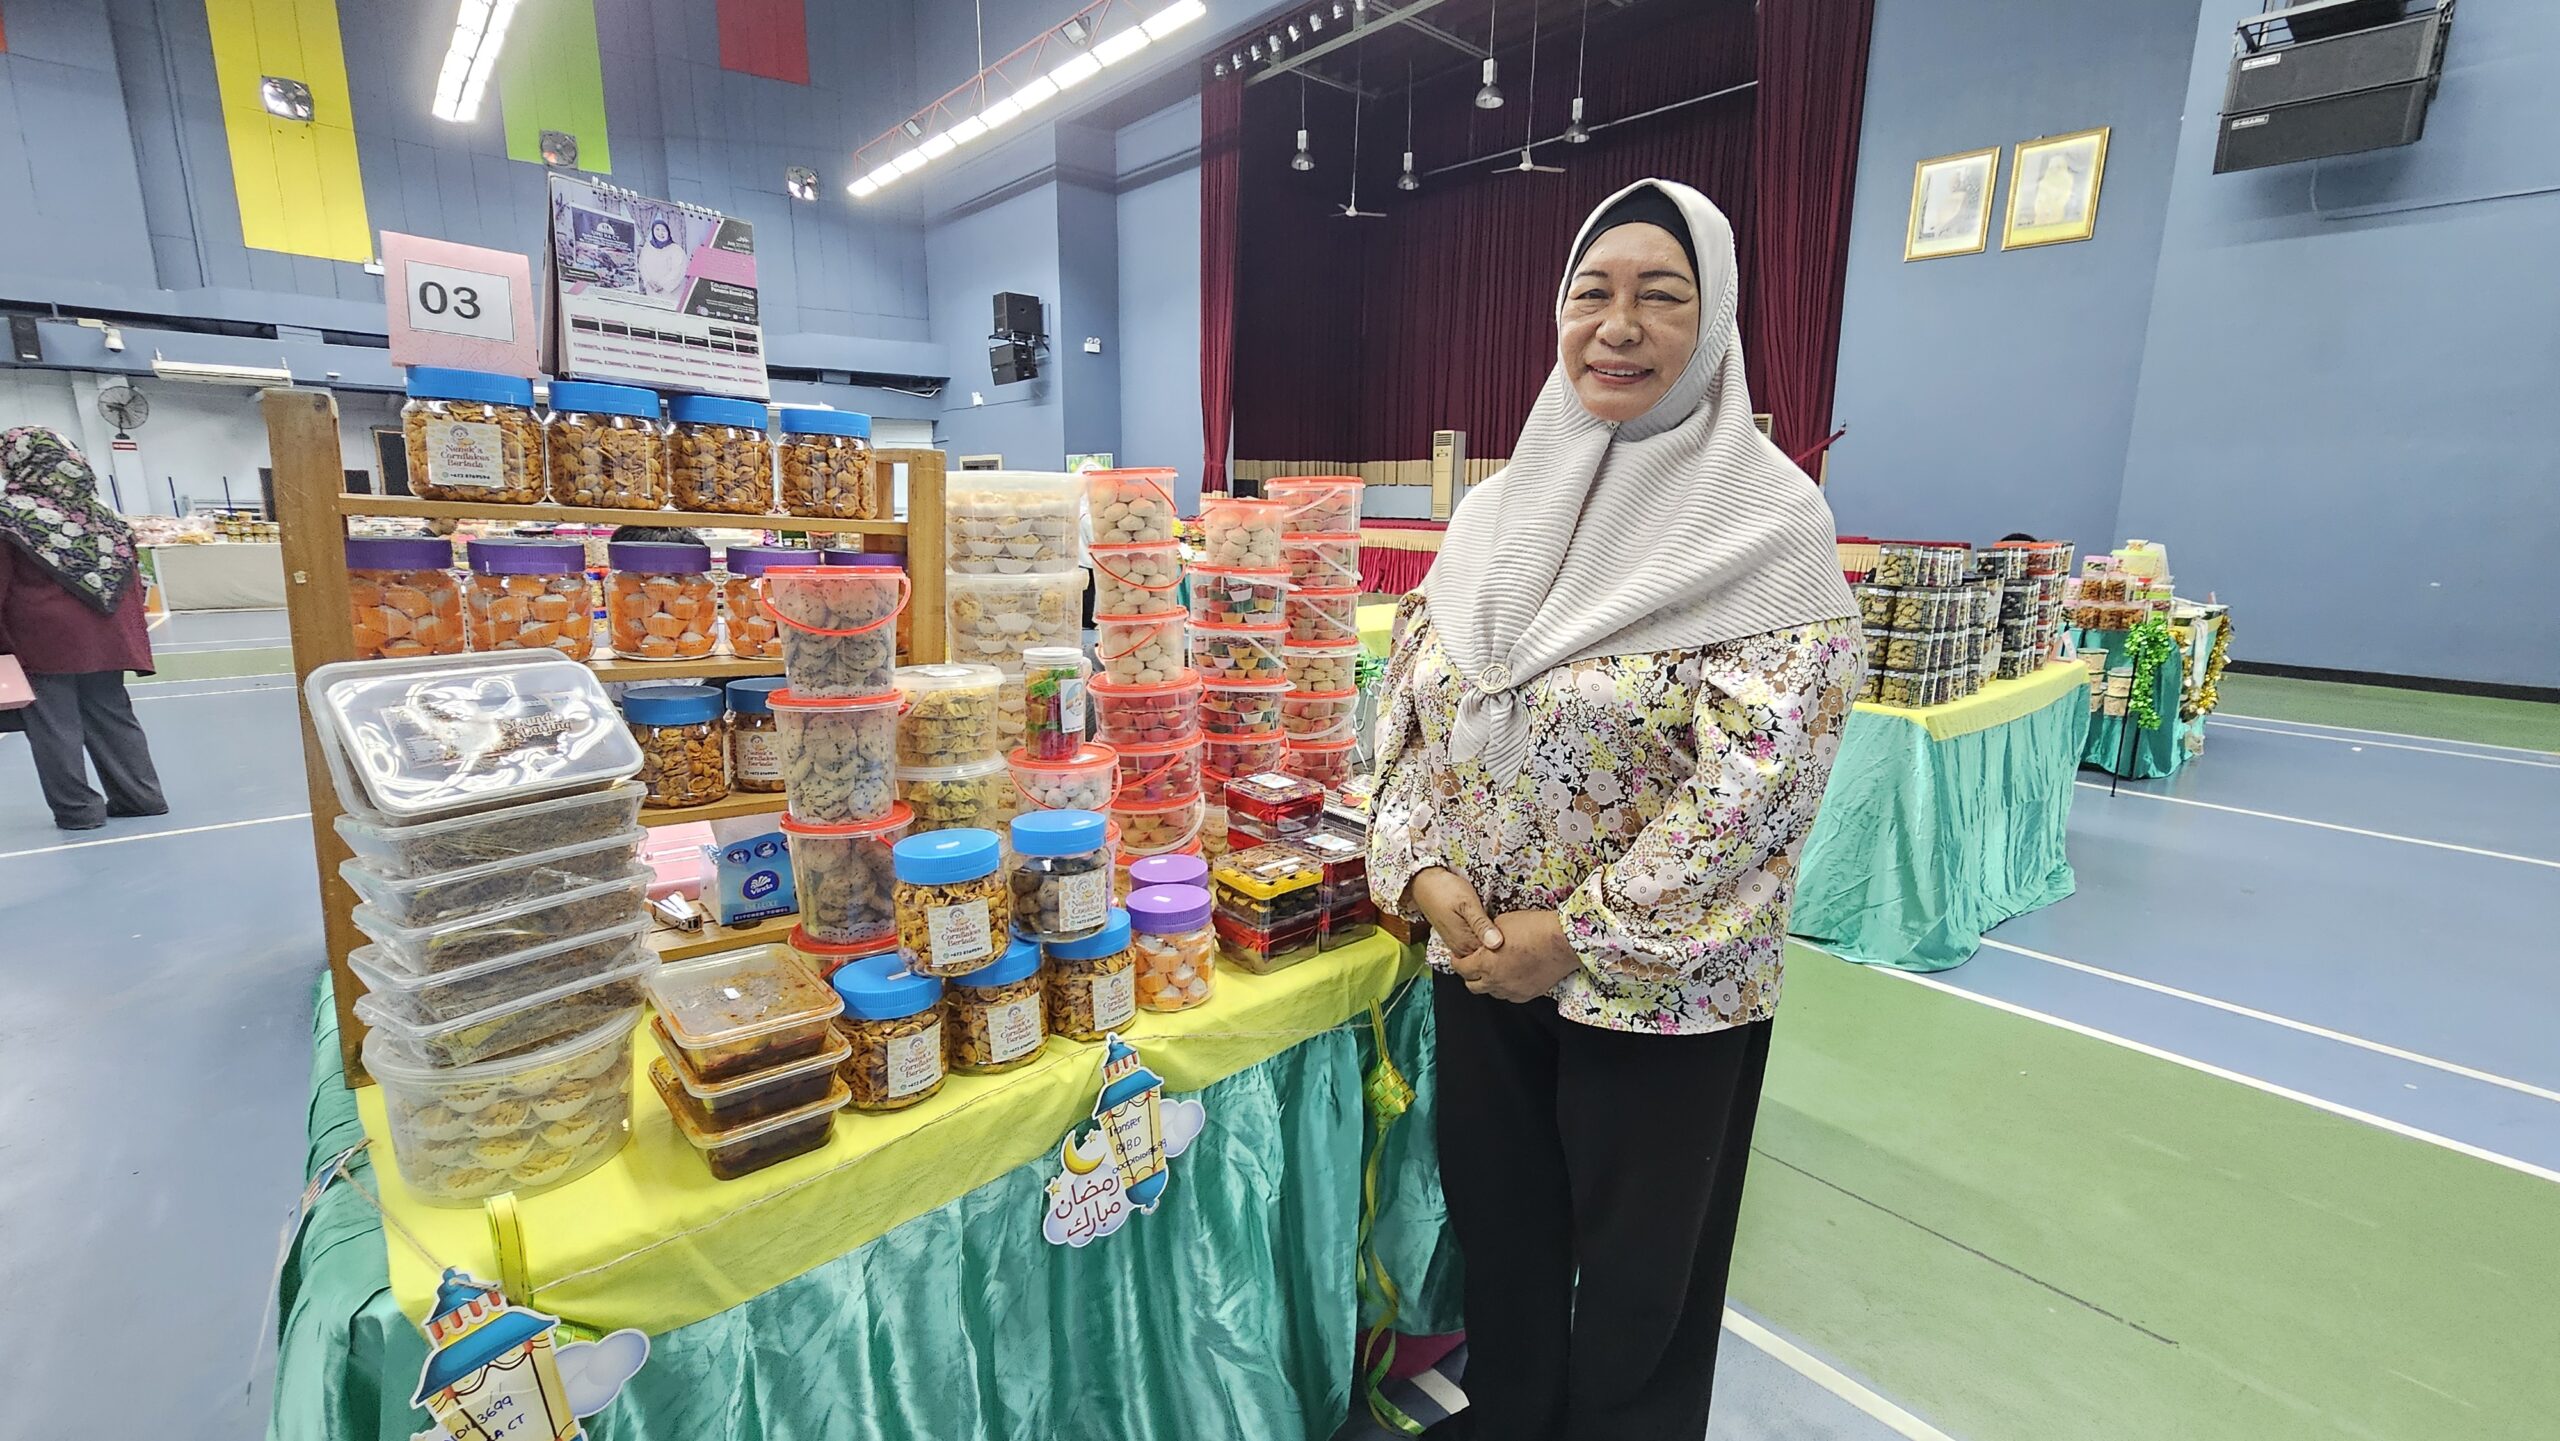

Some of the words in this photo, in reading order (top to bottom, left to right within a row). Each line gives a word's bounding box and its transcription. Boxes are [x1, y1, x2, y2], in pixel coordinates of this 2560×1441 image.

[419, 281, 480, 320] 03
[750, 884, 773, 895] Vinda
[734, 911, 765, 920] KITCHEN
[766, 907, 788, 915] TOWEL
[1107, 1115, 1142, 1137] Transfer
[1116, 1136, 1142, 1155] BIBD
[1056, 1176, 1120, 1220] رمضان
[1067, 1200, 1121, 1238] مبارك
[507, 1413, 525, 1430] CT
